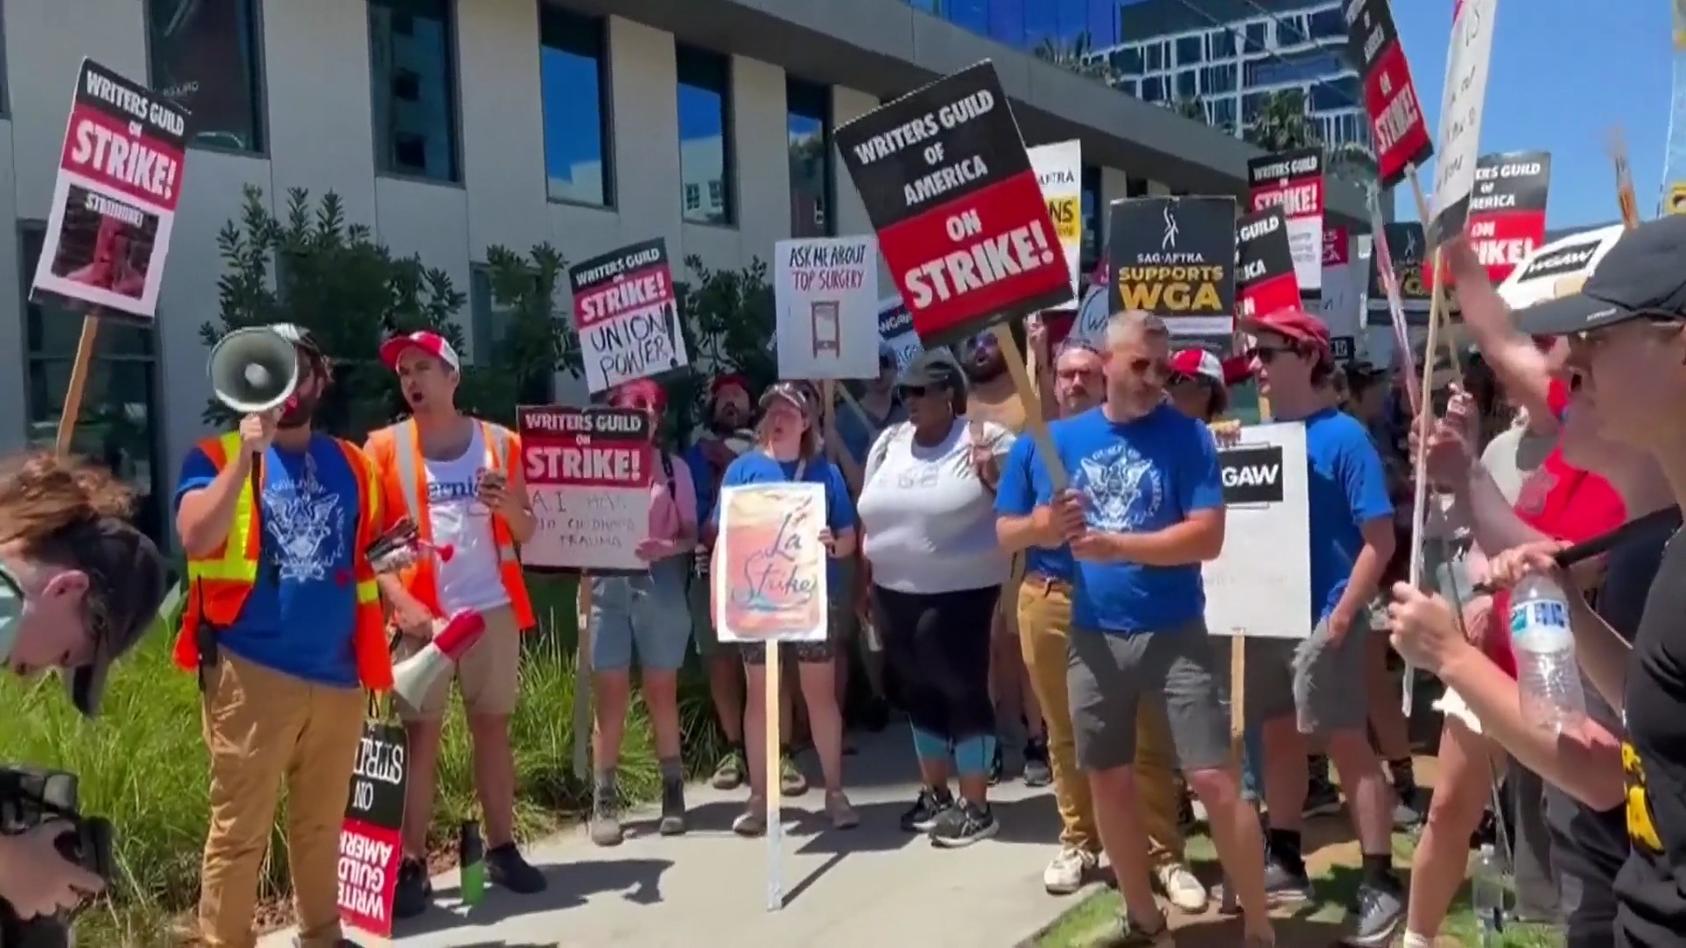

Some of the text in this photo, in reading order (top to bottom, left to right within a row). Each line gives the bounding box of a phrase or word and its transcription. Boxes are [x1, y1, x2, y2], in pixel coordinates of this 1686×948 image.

[87, 70, 185, 137] WRITERS GUILD
[854, 89, 995, 165] WRITERS GUILD
[71, 119, 177, 200] STRIKE!
[924, 142, 945, 166] OF
[1291, 155, 1318, 174] GUILD
[903, 155, 989, 207] AMERICA
[1500, 162, 1541, 178] GUILD
[1471, 194, 1516, 210] ERICA
[1480, 182, 1494, 193] OF
[946, 209, 983, 242] ON
[1050, 200, 1074, 223] NS
[1240, 215, 1280, 242] GUILD
[576, 247, 661, 286] WRITERS GUILD
[789, 244, 866, 268] ASK ME ABOUT
[904, 219, 1055, 310] STRIKE!
[1472, 237, 1534, 267] IKE!
[793, 268, 865, 292] TOP SURGERY
[1118, 265, 1225, 281] SUPPORTS
[581, 271, 667, 323] STRIKE!
[1118, 281, 1224, 311] WGA
[590, 304, 667, 352] UNION
[525, 413, 642, 433] WRITERS GUILD
[575, 433, 592, 446] ON
[525, 446, 641, 482] STRIKE!
[1222, 463, 1280, 487] GAW
[353, 737, 405, 785] STRI
[353, 780, 374, 811] ON
[340, 829, 395, 869] AMERI
[337, 856, 385, 894] GUILD
[337, 880, 386, 922] WRITE
